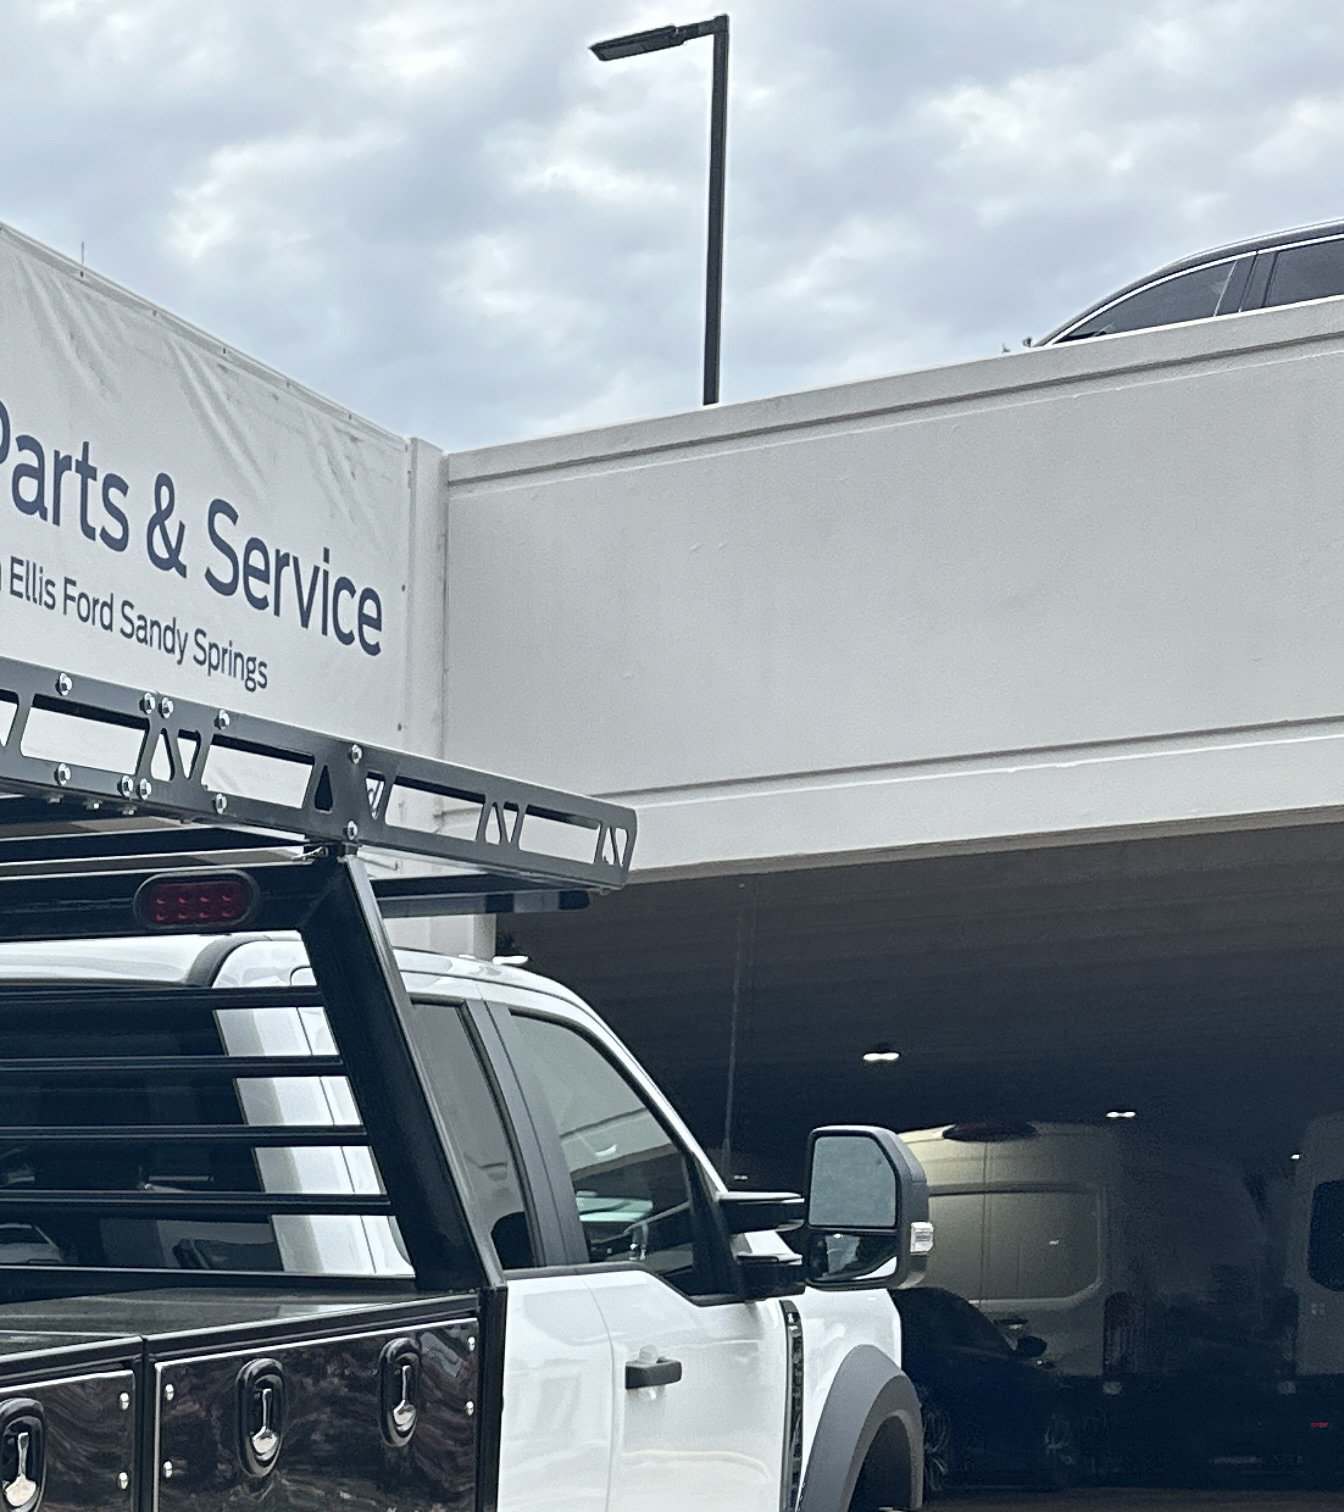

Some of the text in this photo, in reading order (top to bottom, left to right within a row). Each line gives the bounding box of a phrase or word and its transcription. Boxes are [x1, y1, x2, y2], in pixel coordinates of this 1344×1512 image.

[9, 556, 56, 610] Ellis
[63, 576, 114, 632] Ford
[120, 600, 188, 665] Sandy
[193, 628, 268, 692] Springs
[147, 473, 187, 578] &
[205, 499, 382, 656] Service
